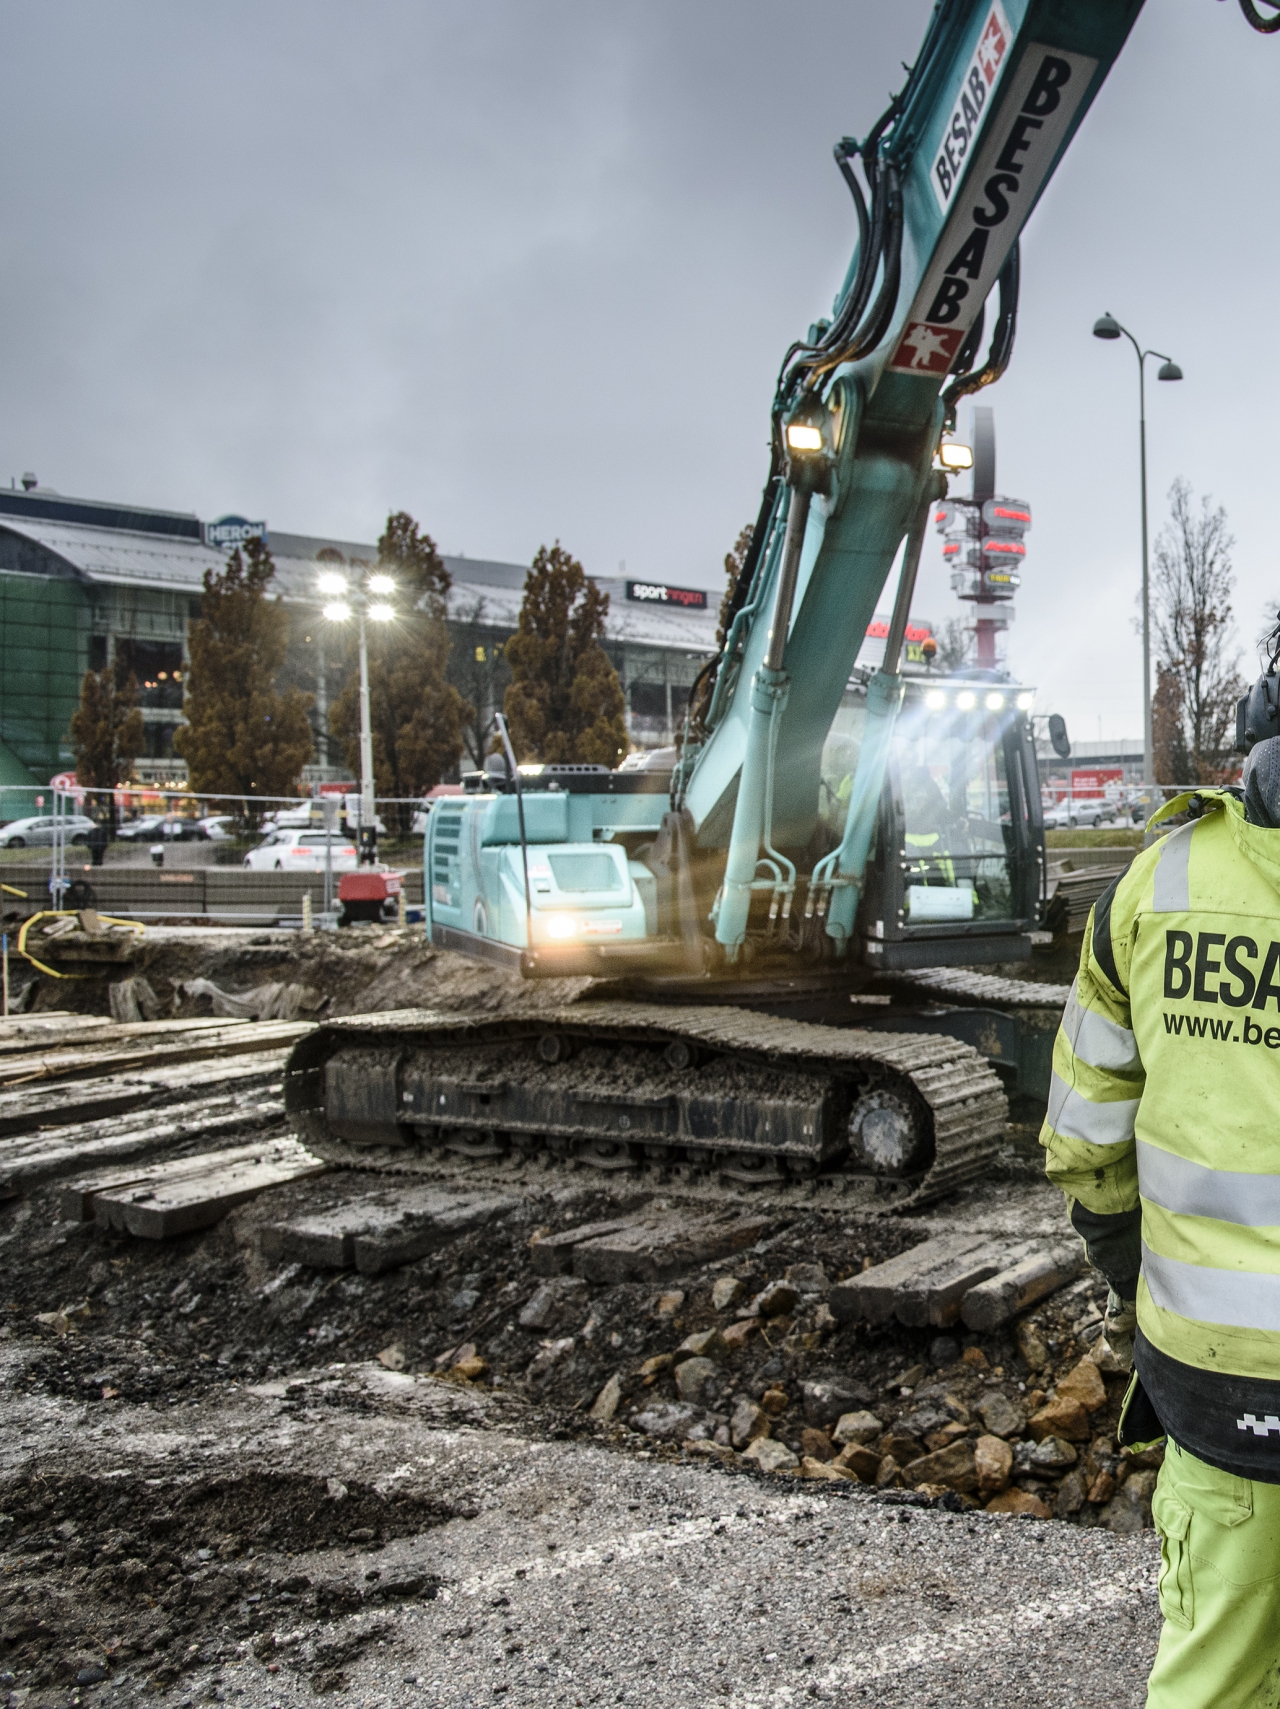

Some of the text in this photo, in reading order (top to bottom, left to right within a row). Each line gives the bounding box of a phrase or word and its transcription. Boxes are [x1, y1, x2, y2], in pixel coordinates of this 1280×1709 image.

[924, 55, 1071, 324] BESAB
[936, 66, 986, 201] BESAB
[209, 525, 263, 540] HERON
